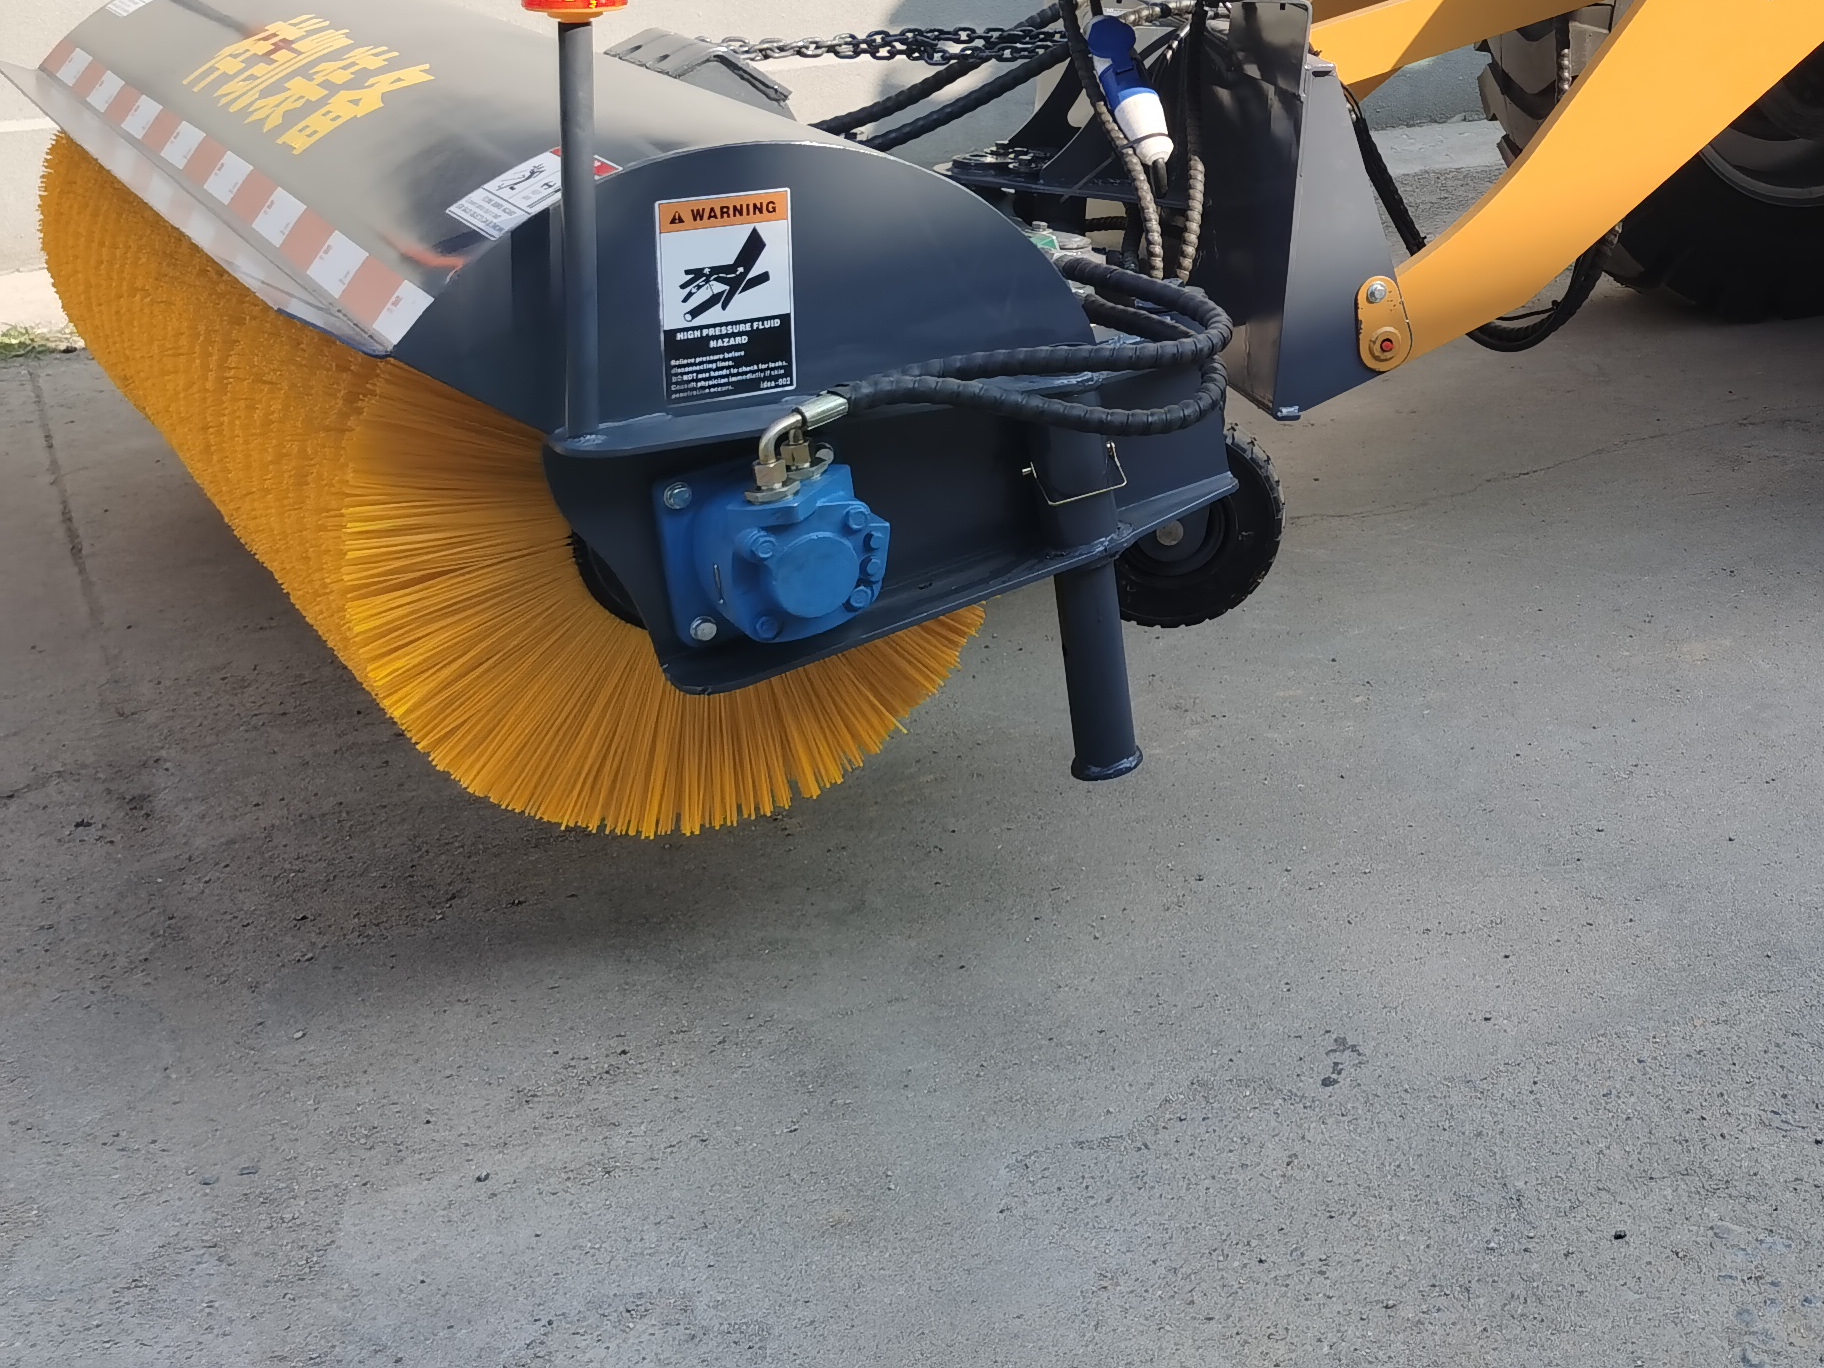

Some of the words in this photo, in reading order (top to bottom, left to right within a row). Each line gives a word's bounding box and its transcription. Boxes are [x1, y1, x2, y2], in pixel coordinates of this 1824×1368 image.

[690, 200, 777, 222] WARNING
[676, 329, 701, 340] HIGH
[702, 322, 751, 337] PRESSURE
[753, 318, 781, 330] FLUID
[709, 335, 749, 348] HAZARD
[695, 354, 724, 364] pressure
[724, 350, 745, 359] before
[683, 373, 697, 381] NOT
[710, 368, 730, 377] hands
[738, 364, 758, 373] check
[758, 362, 769, 370] for
